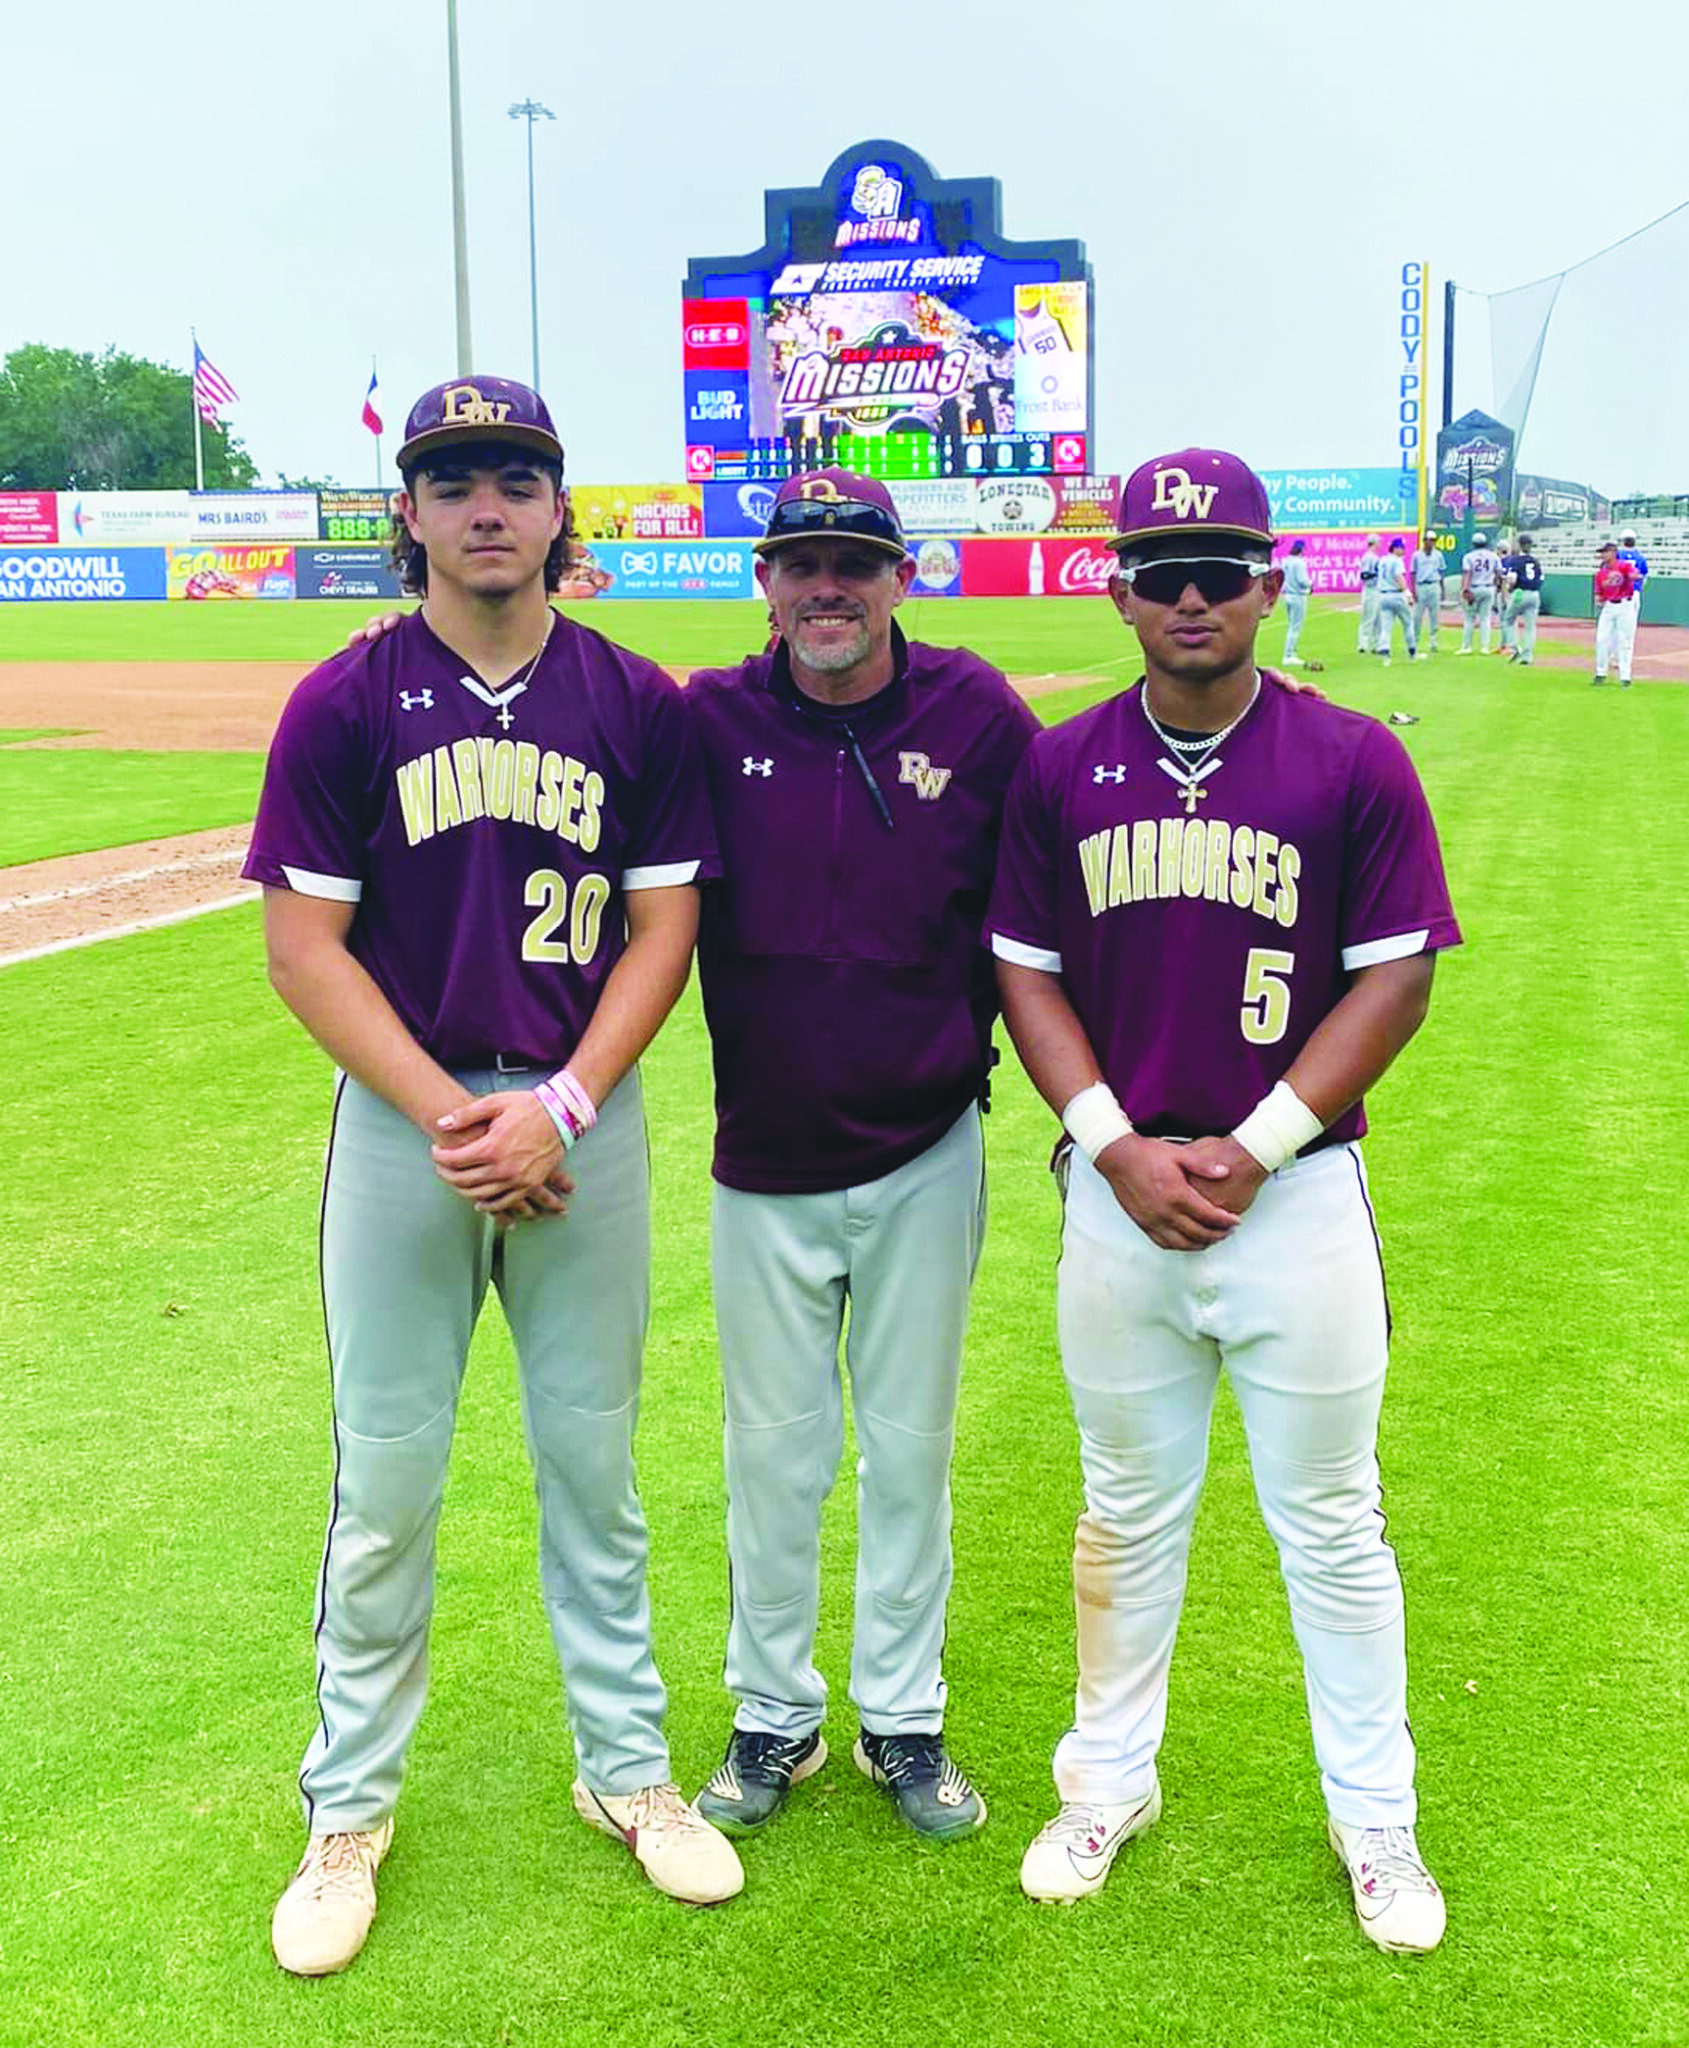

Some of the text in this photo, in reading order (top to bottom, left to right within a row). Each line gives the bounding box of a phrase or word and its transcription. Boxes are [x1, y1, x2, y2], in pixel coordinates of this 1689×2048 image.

[834, 218, 922, 247] MISSIONS
[825, 255, 986, 280] SECURITY SERVICE
[1401, 262, 1421, 363] CODY
[1034, 335, 1058, 355] 50
[783, 350, 971, 402] MISSIONS
[697, 391, 736, 404] BUD
[691, 404, 744, 420] LIGHT
[961, 435, 987, 444] BALLS
[1026, 433, 1050, 442] OUTS
[1398, 374, 1419, 500] POOLS
[1029, 443, 1045, 468] 3
[979, 482, 1051, 503] LONESTAR
[1151, 467, 1220, 520] DW
[1286, 474, 1352, 493] People.
[1061, 488, 1114, 502] VEHICLES
[1286, 494, 1395, 514] Community.
[198, 512, 221, 525] MRS
[633, 504, 691, 518] NACHOS
[634, 519, 699, 534] FOR ALL!
[991, 521, 1035, 532] TOWING
[0, 557, 124, 580] OODWILL
[171, 551, 218, 577] GO
[246, 548, 290, 568] OUT
[662, 552, 743, 574] FAVOR
[1060, 547, 1119, 590] Coca
[1474, 558, 1489, 573] 24
[1525, 563, 1535, 580] 5
[30, 579, 126, 597] ANTONIO
[1078, 818, 1302, 928] WARHORSES
[521, 868, 610, 965] 20
[1240, 947, 1296, 1045] 5
